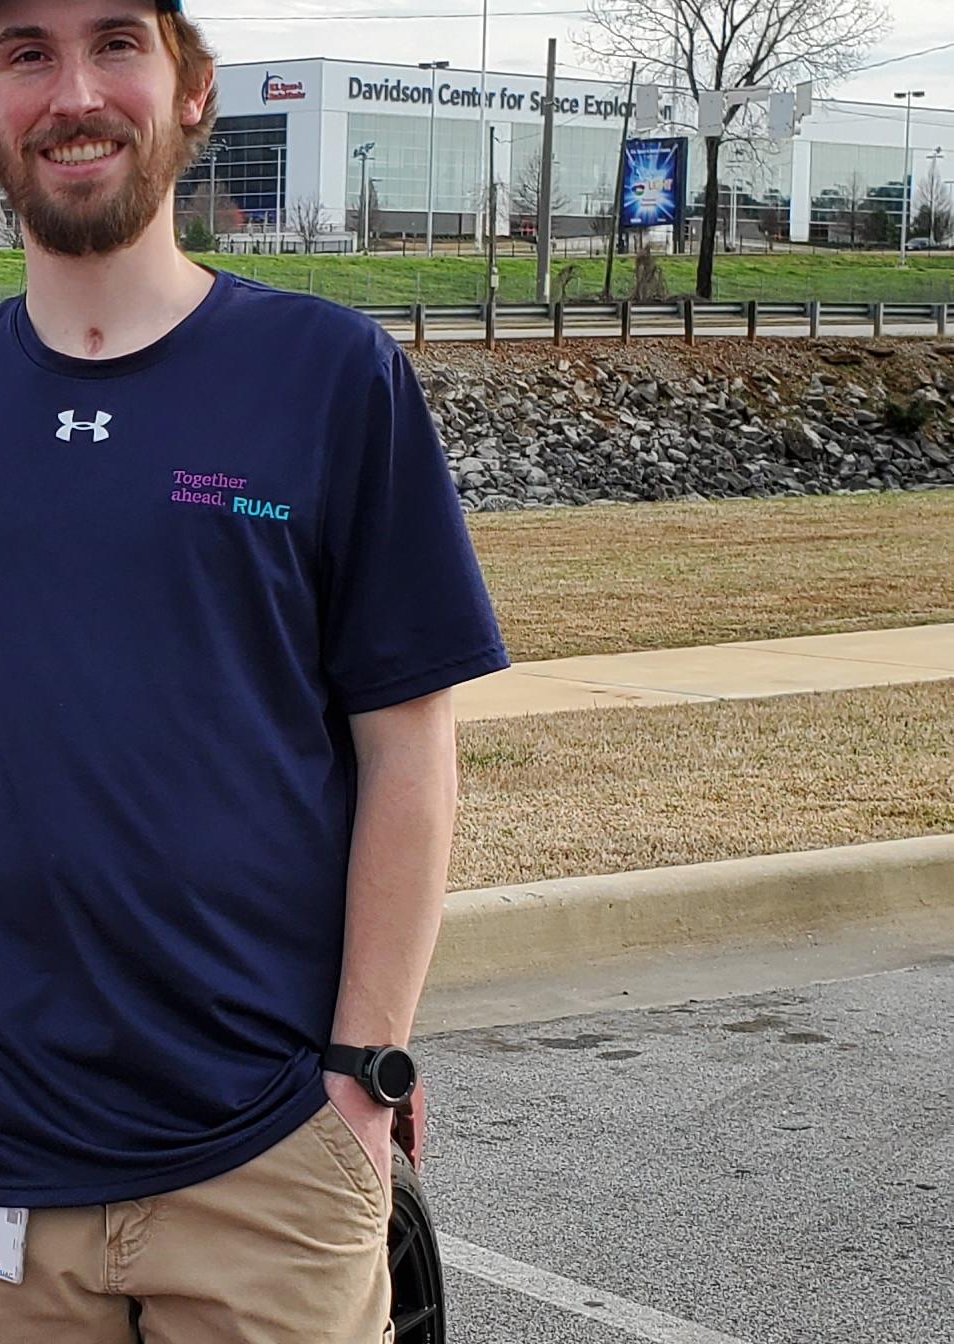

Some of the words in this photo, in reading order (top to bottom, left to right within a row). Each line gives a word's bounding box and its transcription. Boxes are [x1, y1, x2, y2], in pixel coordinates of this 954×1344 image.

[348, 77, 434, 105] Davidson
[500, 87, 525, 110] for
[172, 470, 248, 490] Together
[170, 488, 227, 507] ahead.
[232, 497, 291, 521] RUAG
